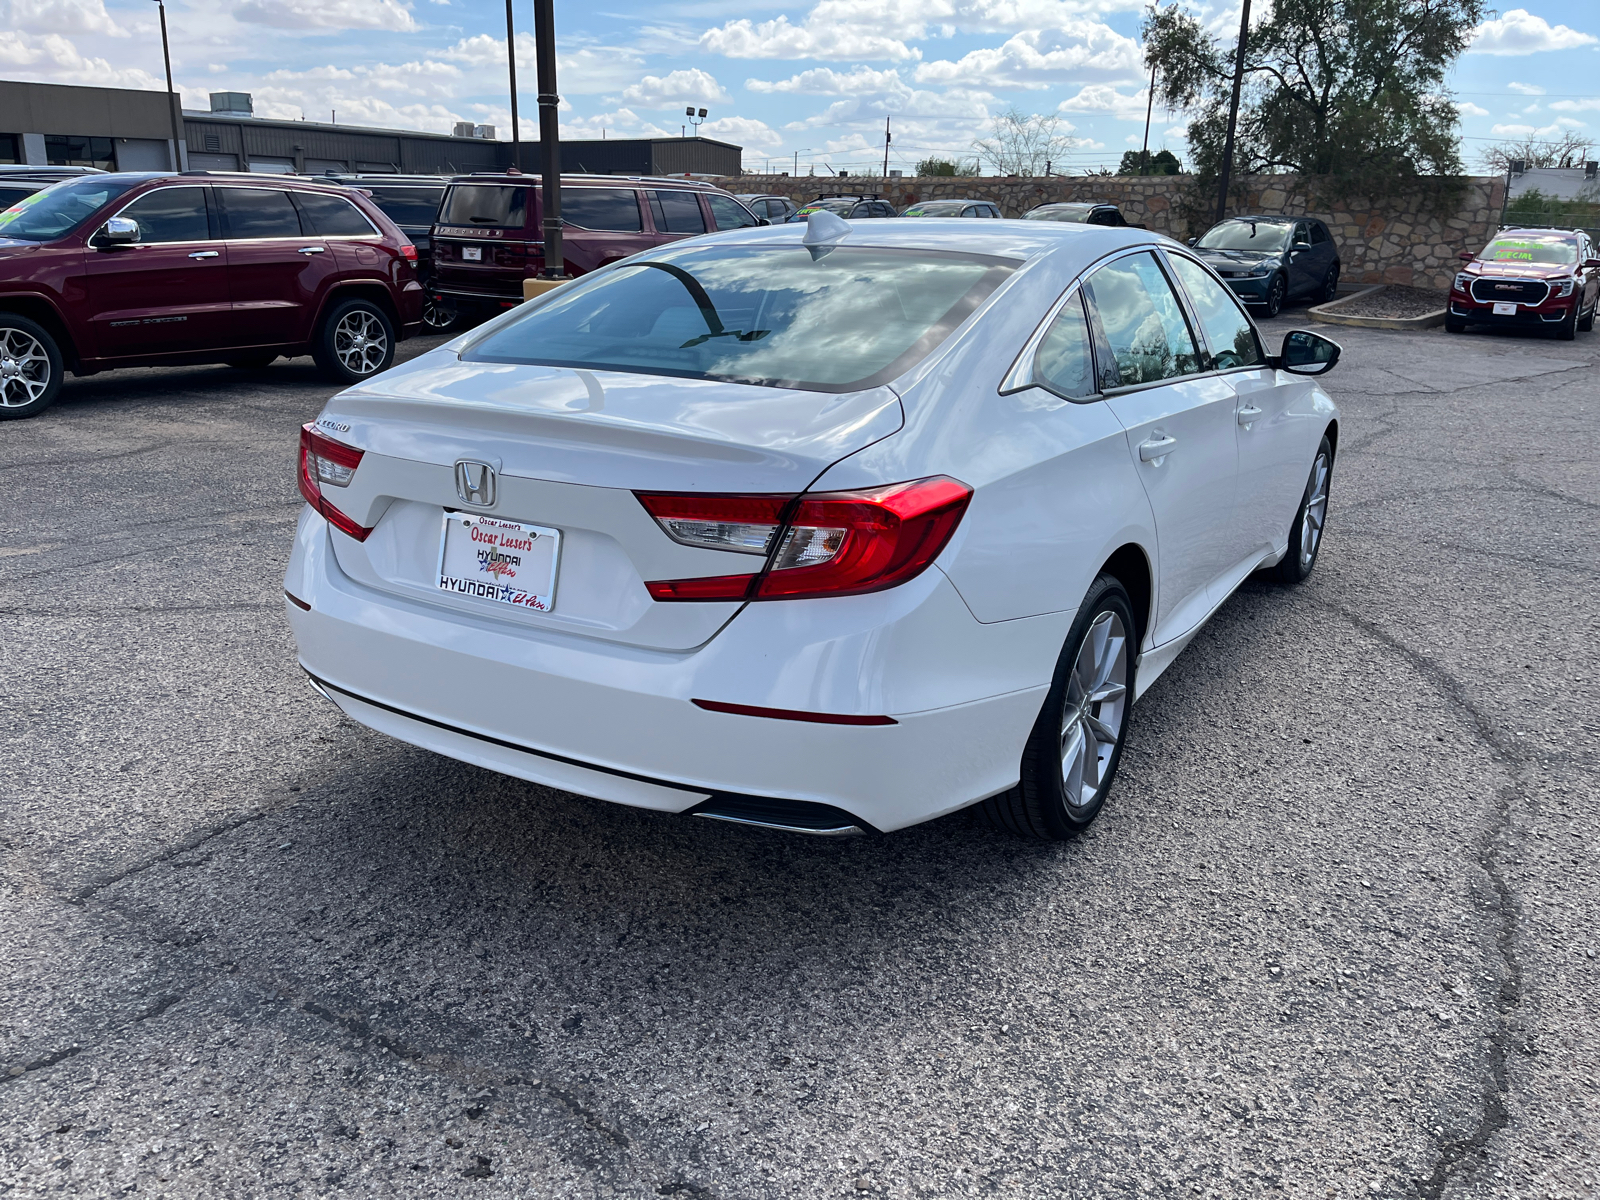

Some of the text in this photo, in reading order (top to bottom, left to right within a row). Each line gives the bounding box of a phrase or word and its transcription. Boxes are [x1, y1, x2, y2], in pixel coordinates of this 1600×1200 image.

[1493, 250, 1533, 260] SPECIAL
[479, 516, 521, 531] Oscar Leeser's
[471, 526, 532, 551] Oscar Leeser's
[477, 549, 521, 567] HYUNDAI
[440, 576, 500, 600] HYUNDAI
[512, 593, 527, 604] El
[525, 595, 546, 611] Paso
